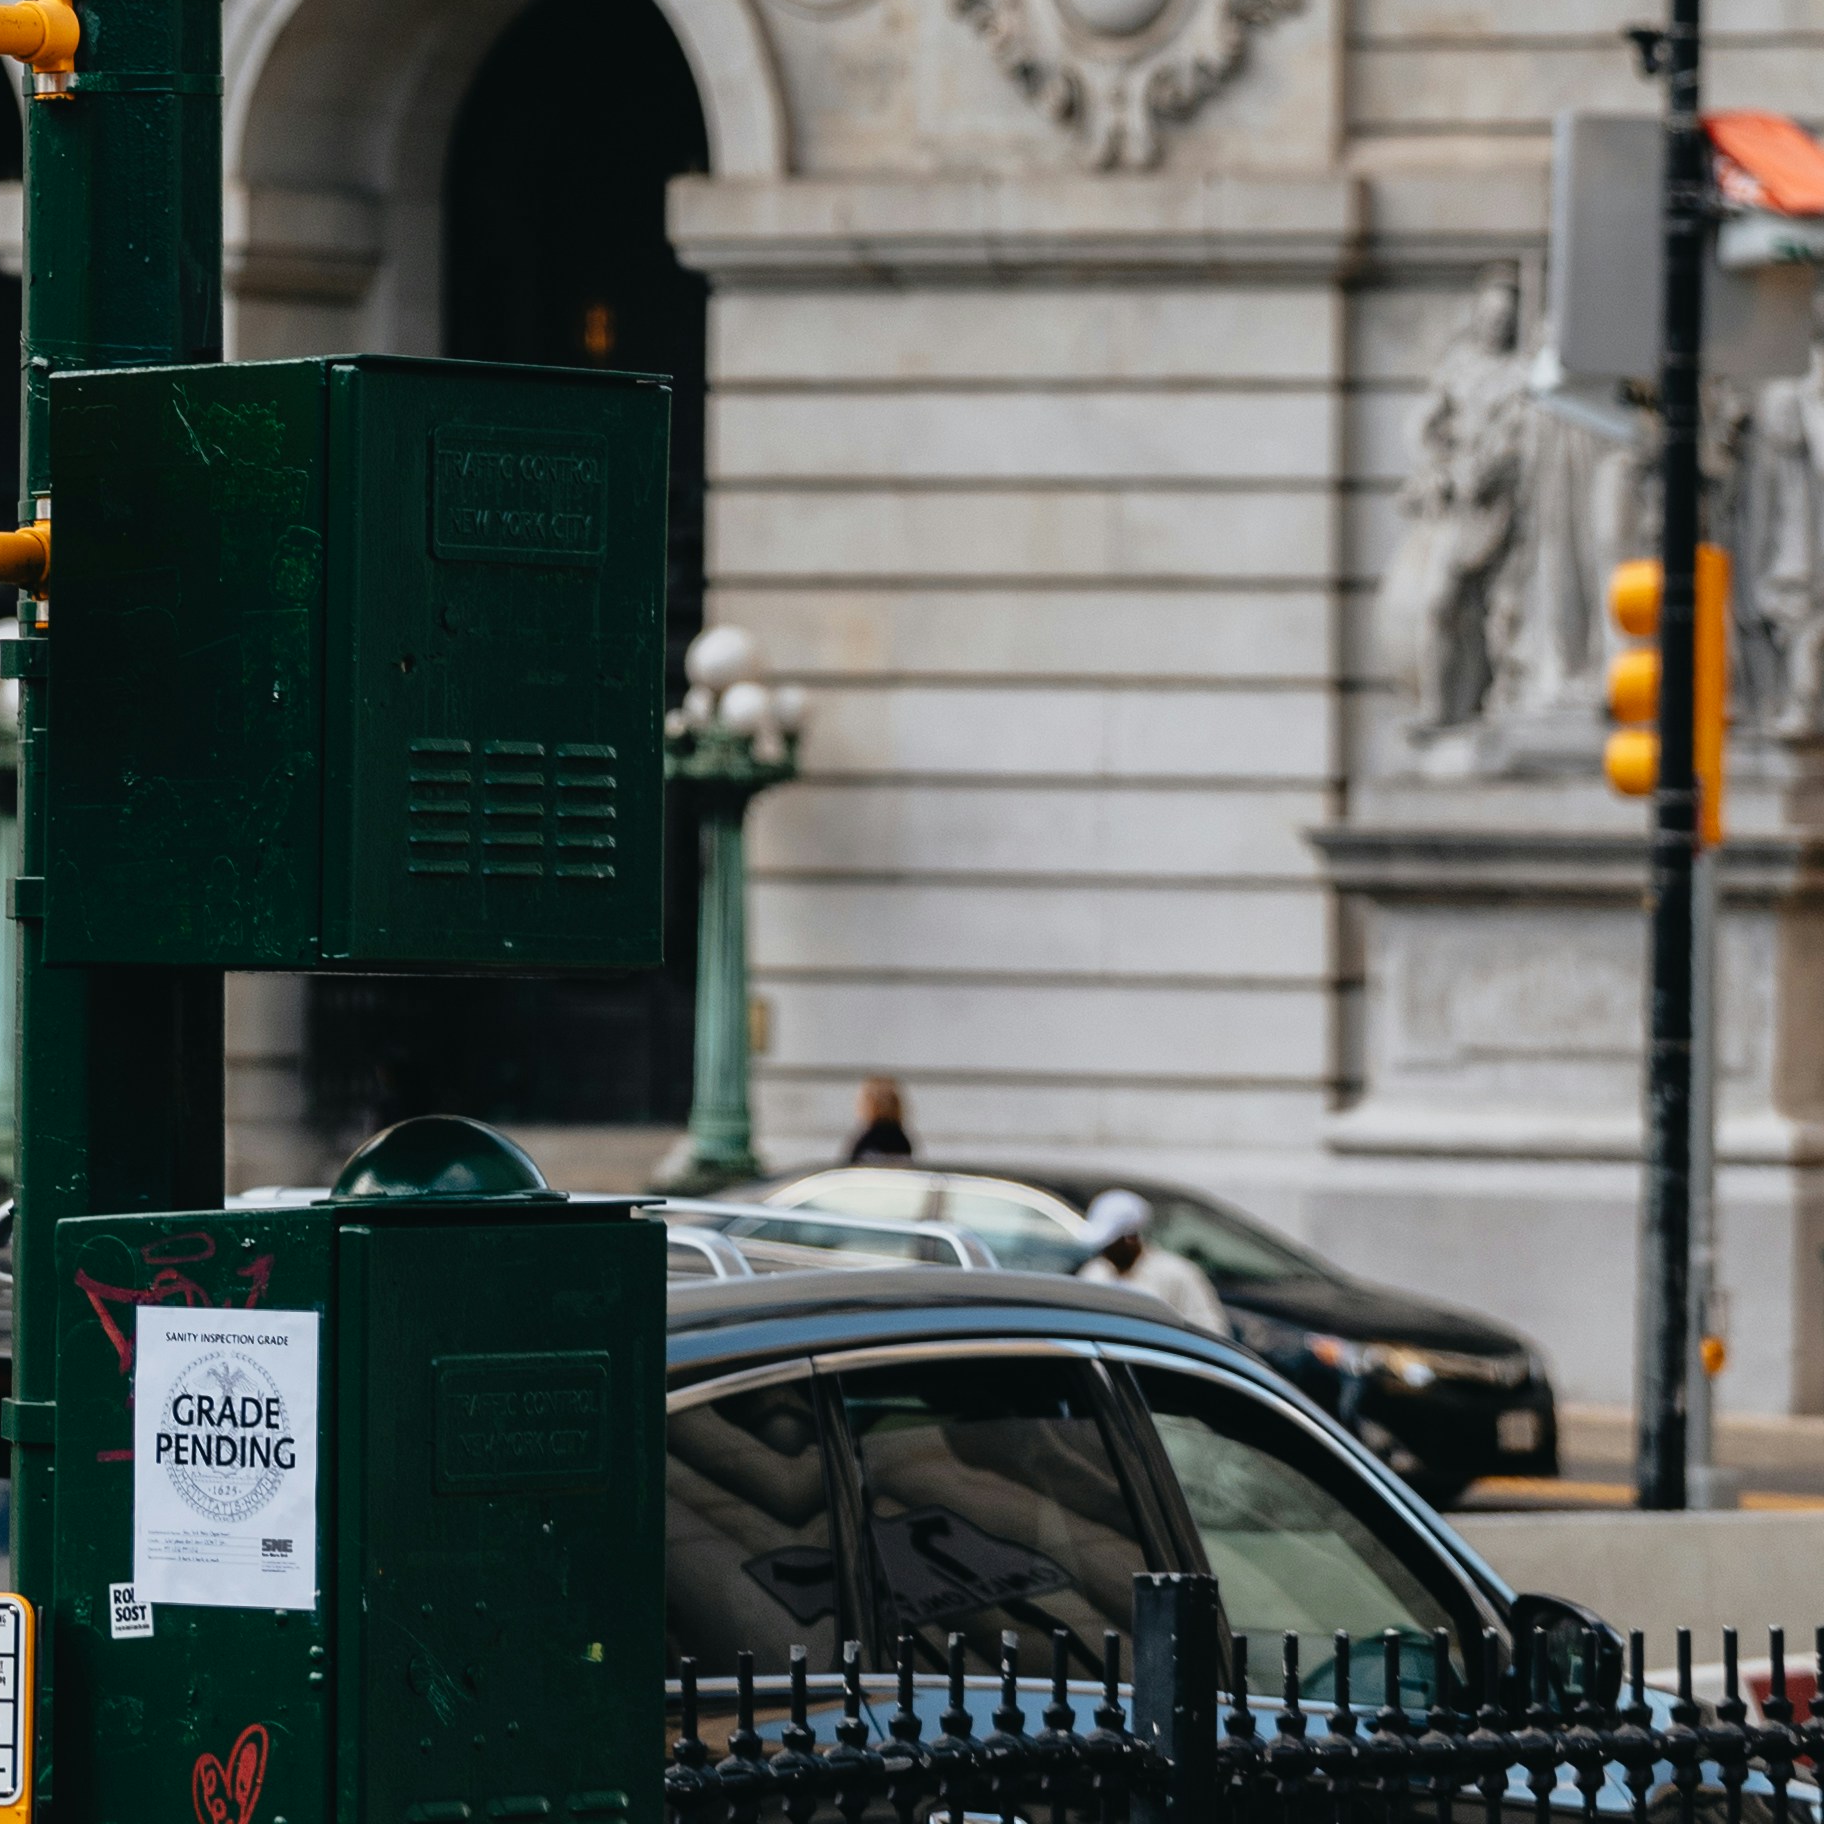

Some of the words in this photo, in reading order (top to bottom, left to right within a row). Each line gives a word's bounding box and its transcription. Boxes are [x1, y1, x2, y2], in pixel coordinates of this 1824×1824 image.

[438, 450, 514, 479] TRAFFIC
[520, 454, 603, 483] CONTROL
[449, 508, 489, 537] NEW
[495, 510, 546, 540] YORK
[551, 512, 593, 540] CITY
[165, 1331, 198, 1342] SANITY
[201, 1333, 255, 1345] INSPECTION
[257, 1335, 289, 1346] GRADE
[172, 1393, 280, 1430] GRADE
[155, 1432, 296, 1470] PENDING
[115, 1605, 147, 1622] SOST
